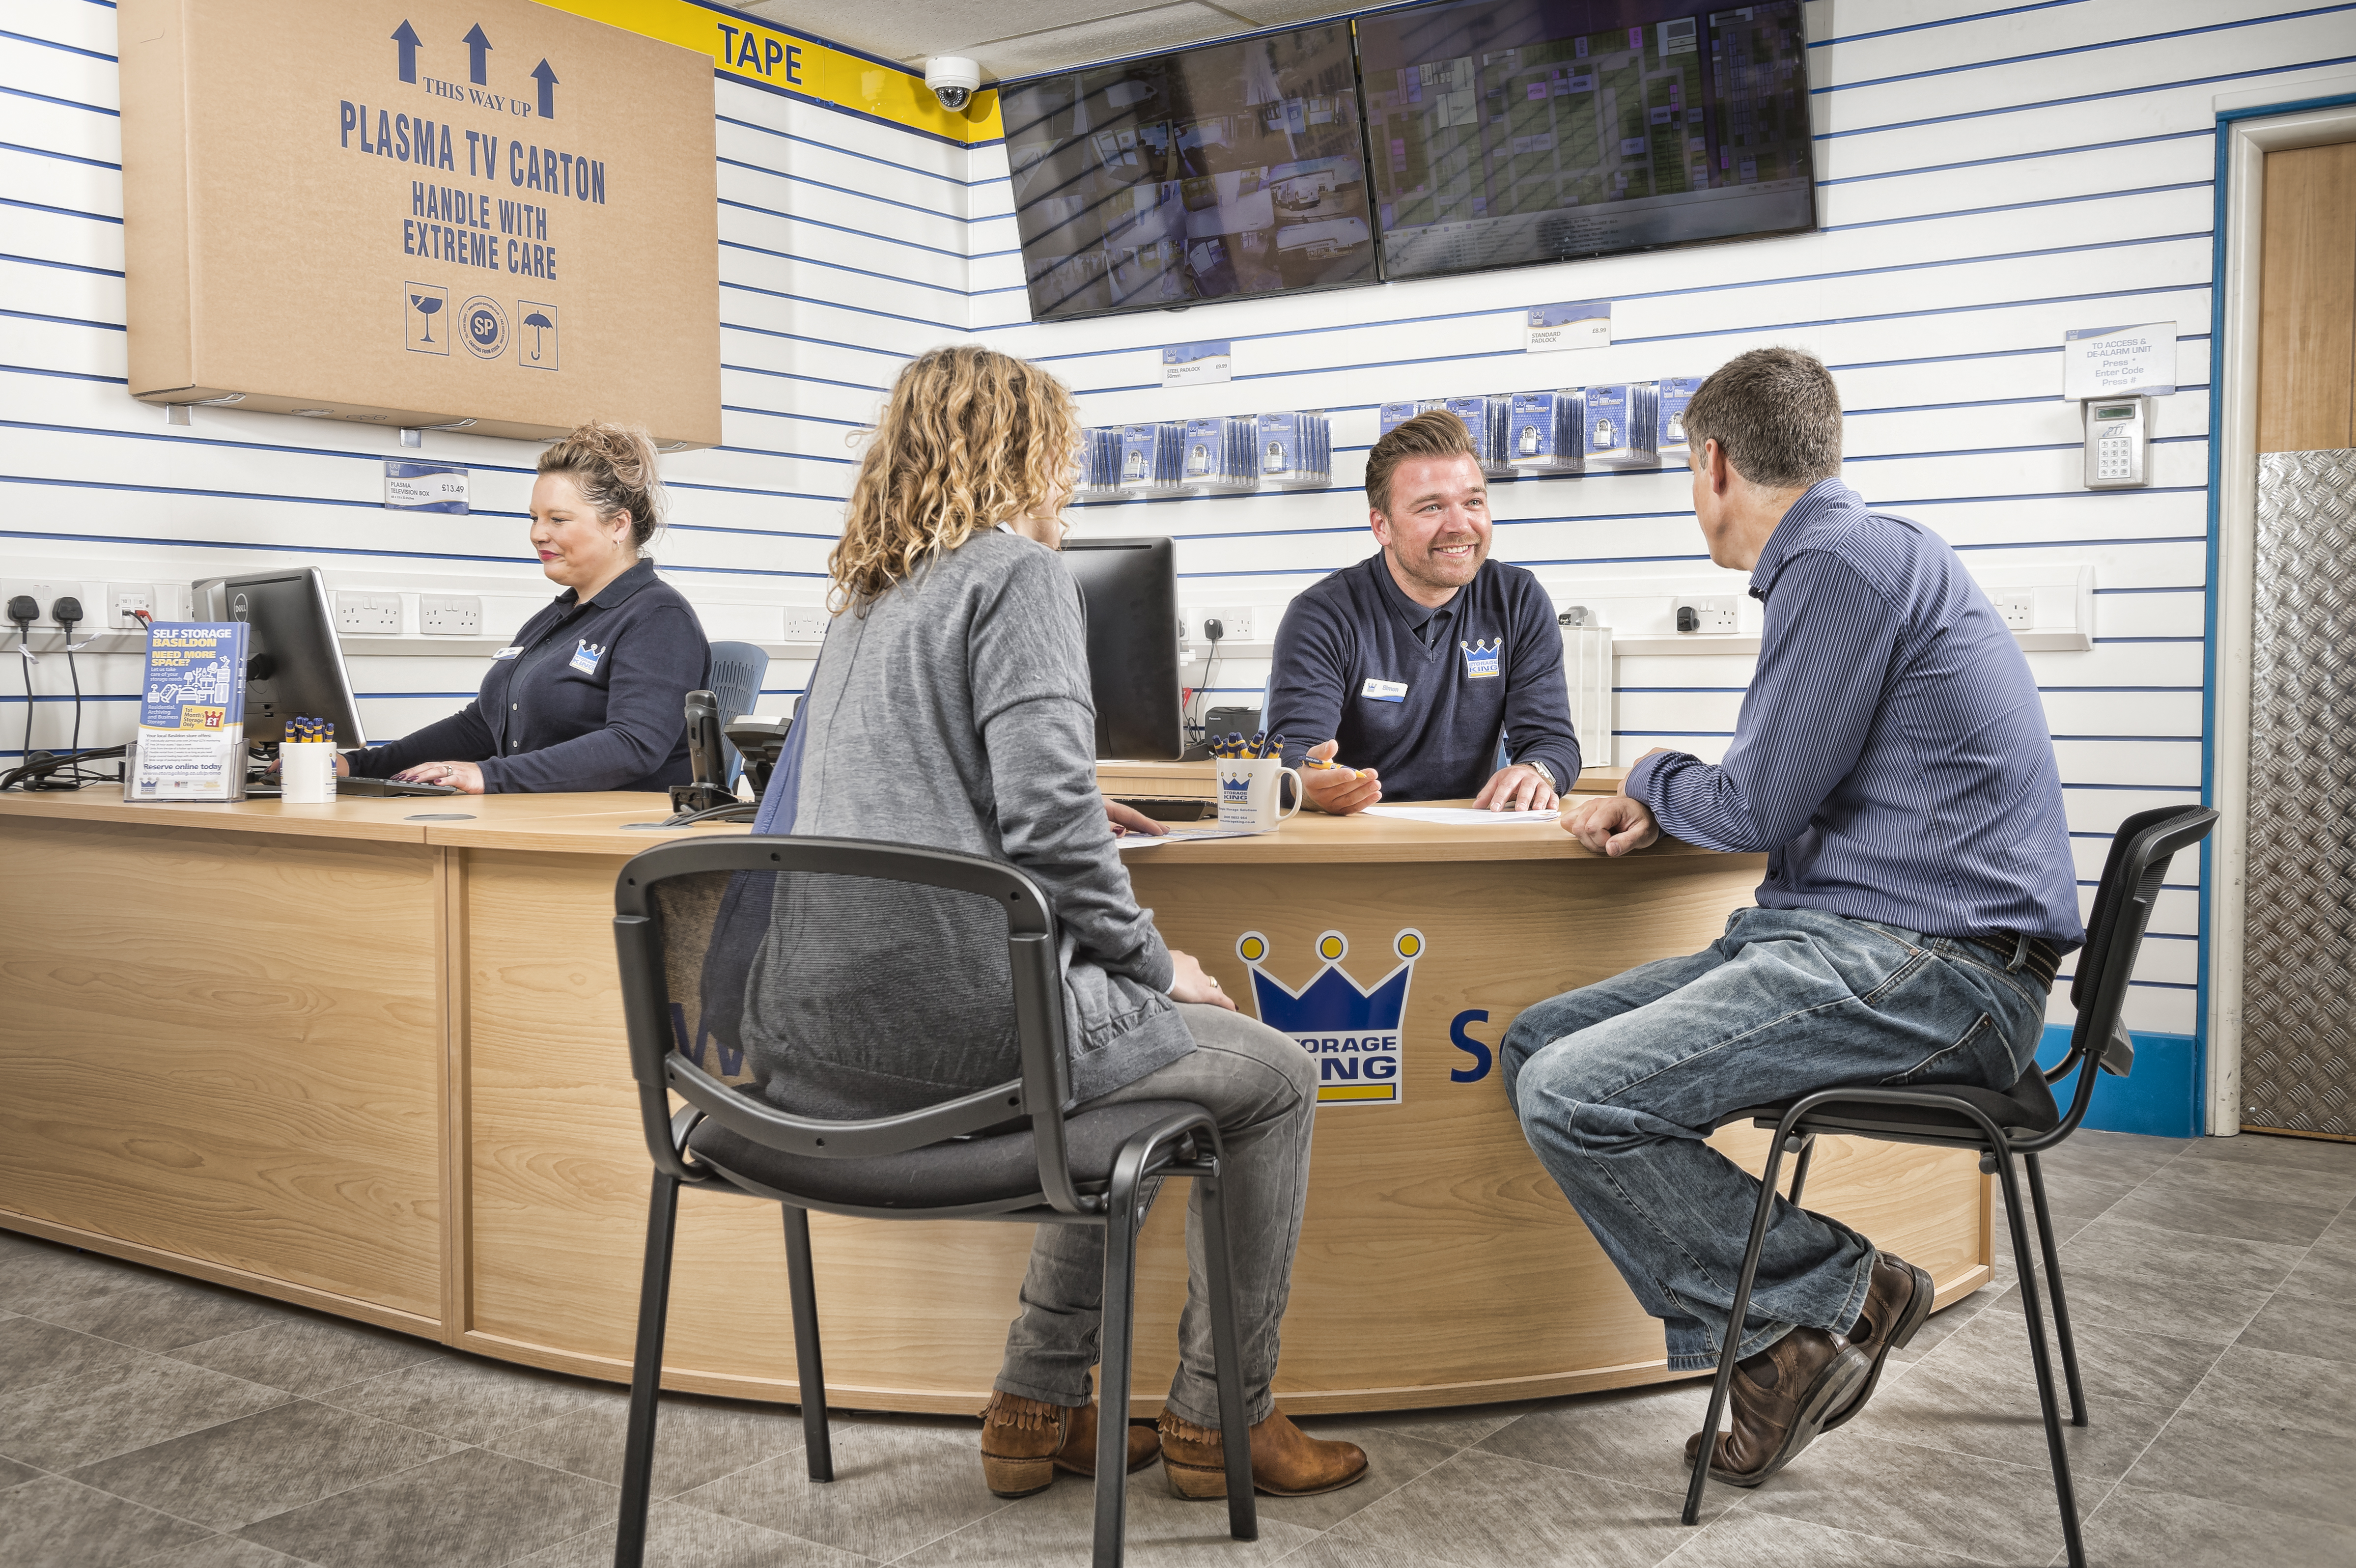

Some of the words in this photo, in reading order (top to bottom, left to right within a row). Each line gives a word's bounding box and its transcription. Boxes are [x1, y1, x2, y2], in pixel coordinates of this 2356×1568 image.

[717, 23, 802, 85] TAPE
[423, 77, 464, 101] THIS
[468, 88, 505, 111] WAY
[510, 99, 531, 117] UP
[340, 100, 455, 172] PLASMA
[465, 130, 497, 180] TV
[509, 140, 605, 205] CARTON
[412, 181, 490, 230] HANDLE
[498, 198, 547, 241] WITH
[403, 219, 499, 270] EXTREME
[507, 239, 557, 280] CARE
[474, 317, 494, 336] SP
[469, 340, 481, 353] CARTONS
[491, 344, 500, 353] STOCK
[2105, 339, 2138, 348] ACCESS
[2087, 348, 2130, 358] DE-ALARM
[442, 484, 464, 493] £13.49
[153, 629, 179, 638] SELF
[180, 629, 232, 638] STORAGE
[152, 638, 217, 647] BASILDON
[572, 659, 595, 671] KING
[1295, 1036, 1397, 1053] ORAGE
[1315, 1056, 1397, 1080] NG
